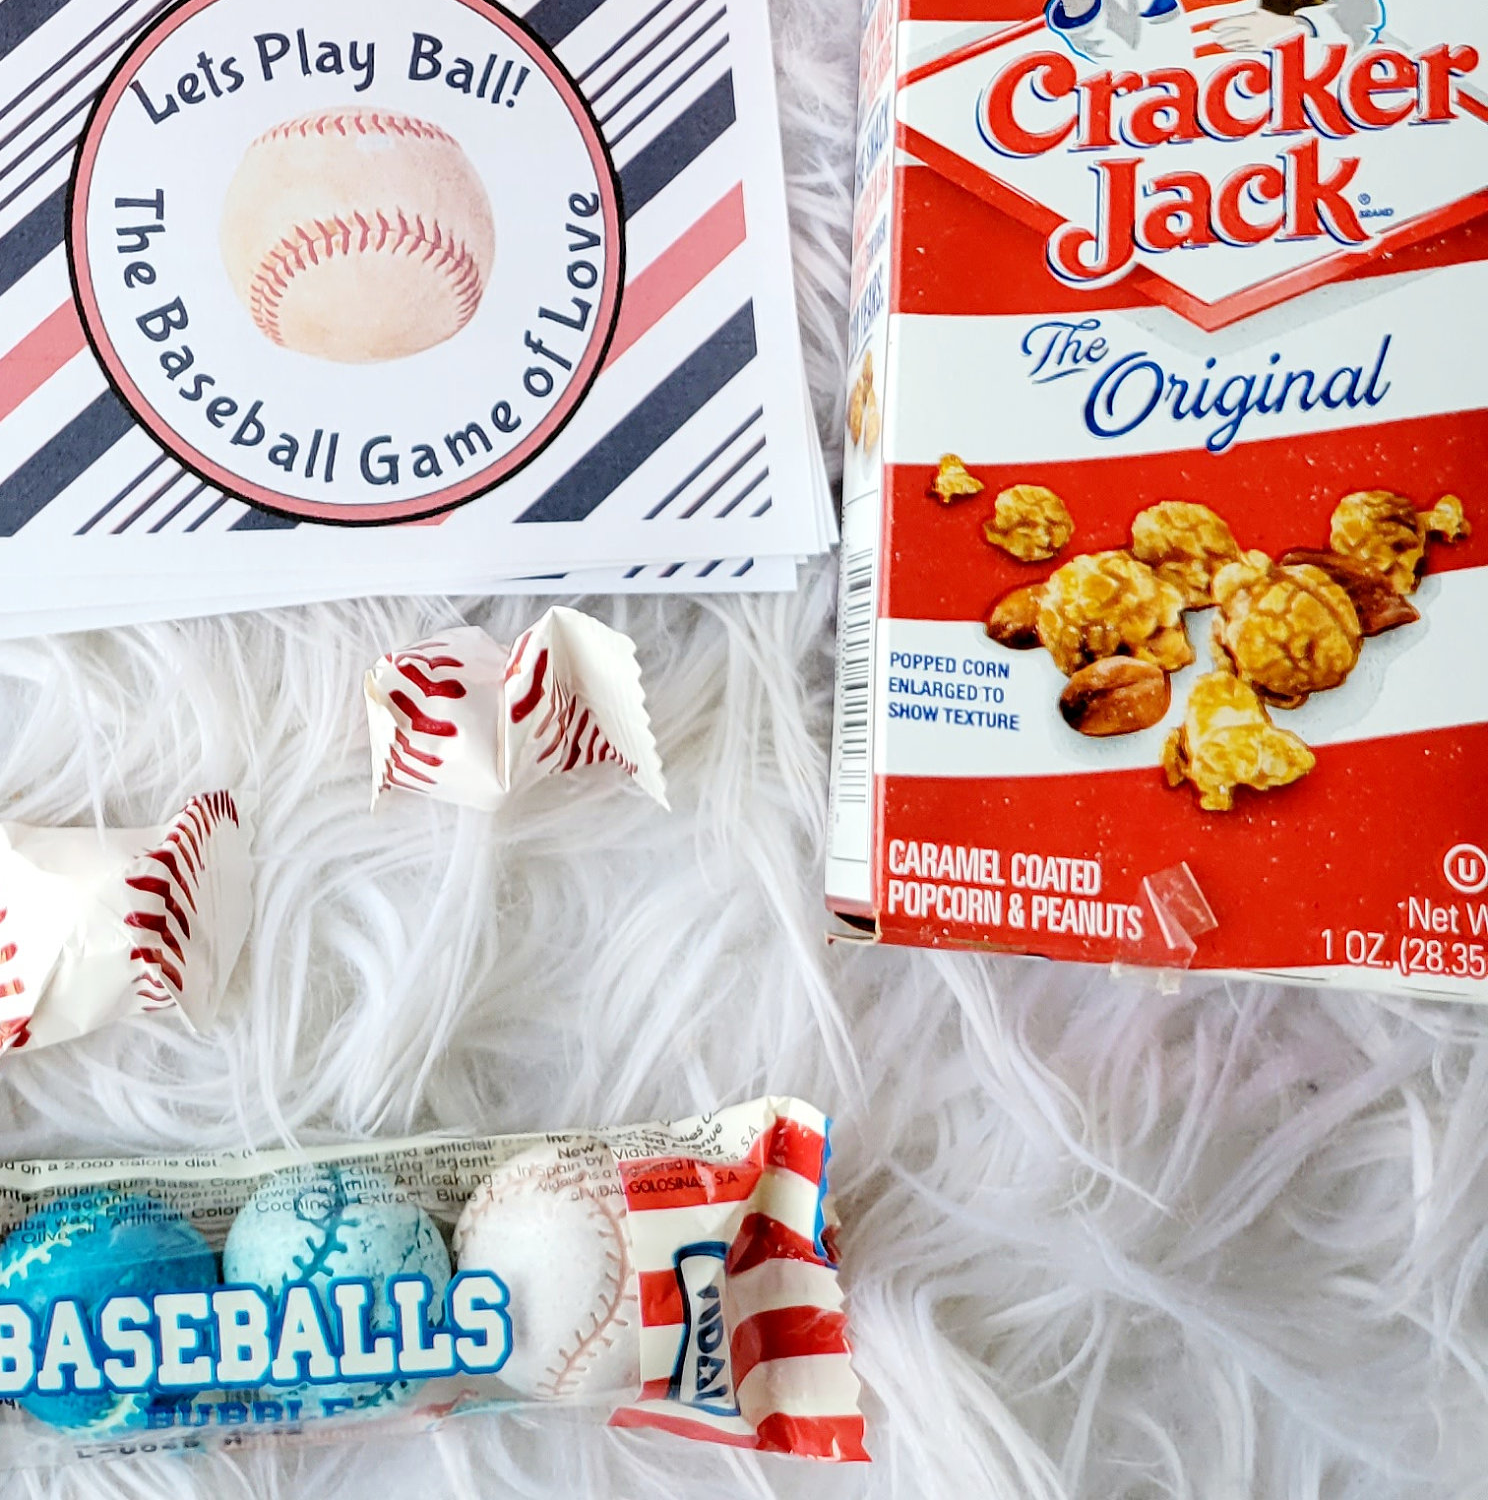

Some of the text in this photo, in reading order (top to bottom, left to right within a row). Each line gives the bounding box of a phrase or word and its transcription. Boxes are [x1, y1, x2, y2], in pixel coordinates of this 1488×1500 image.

[129, 30, 530, 125] Lets Play Ball!
[975, 35, 1482, 158] Cracker
[1045, 140, 1374, 291] Jack
[114, 189, 601, 486] The Baseball Game of Love
[1021, 317, 1109, 384] The
[1083, 334, 1393, 454] Original
[889, 651, 1011, 680] POPPED CORN
[889, 678, 1005, 704] ENLARGED TO
[887, 704, 1021, 733] SHOW TEXTURE
[888, 840, 1102, 894] CARAMEL COATED
[887, 880, 1144, 943] POPCORN & PEANUTS
[1408, 896, 1488, 936] Net W
[1321, 928, 1333, 960] 1
[1345, 929, 1391, 967] OZ.
[588, 1184, 627, 1199] VIDAL
